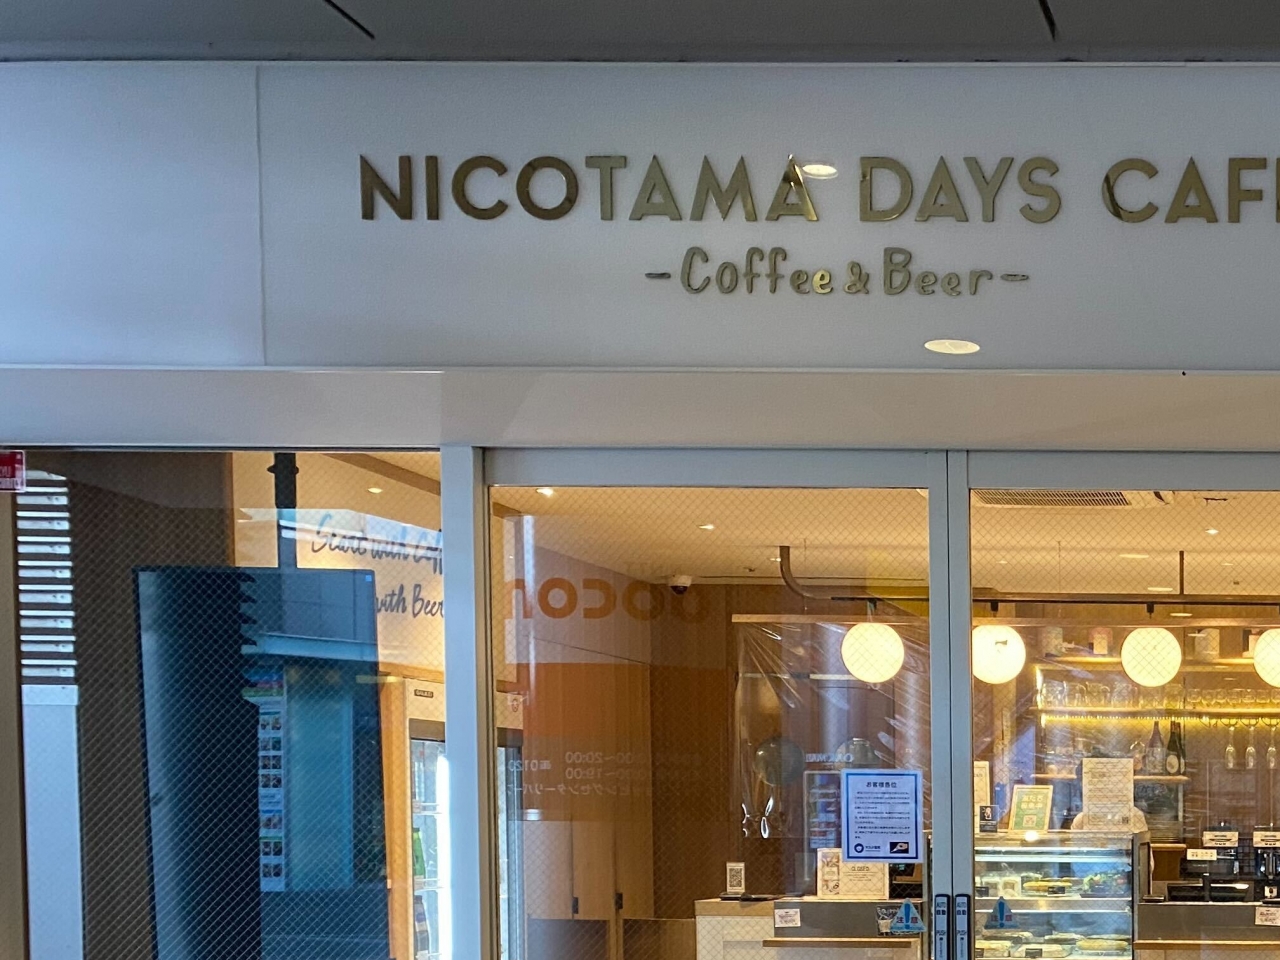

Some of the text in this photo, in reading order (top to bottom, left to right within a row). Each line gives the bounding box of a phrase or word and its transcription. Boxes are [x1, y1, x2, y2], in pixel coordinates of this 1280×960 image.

[359, 154, 820, 223] NICOTAMA
[858, 155, 1061, 224] DAYS
[842, 260, 869, 295] &
[866, 781, 897, 789] お客様各位
